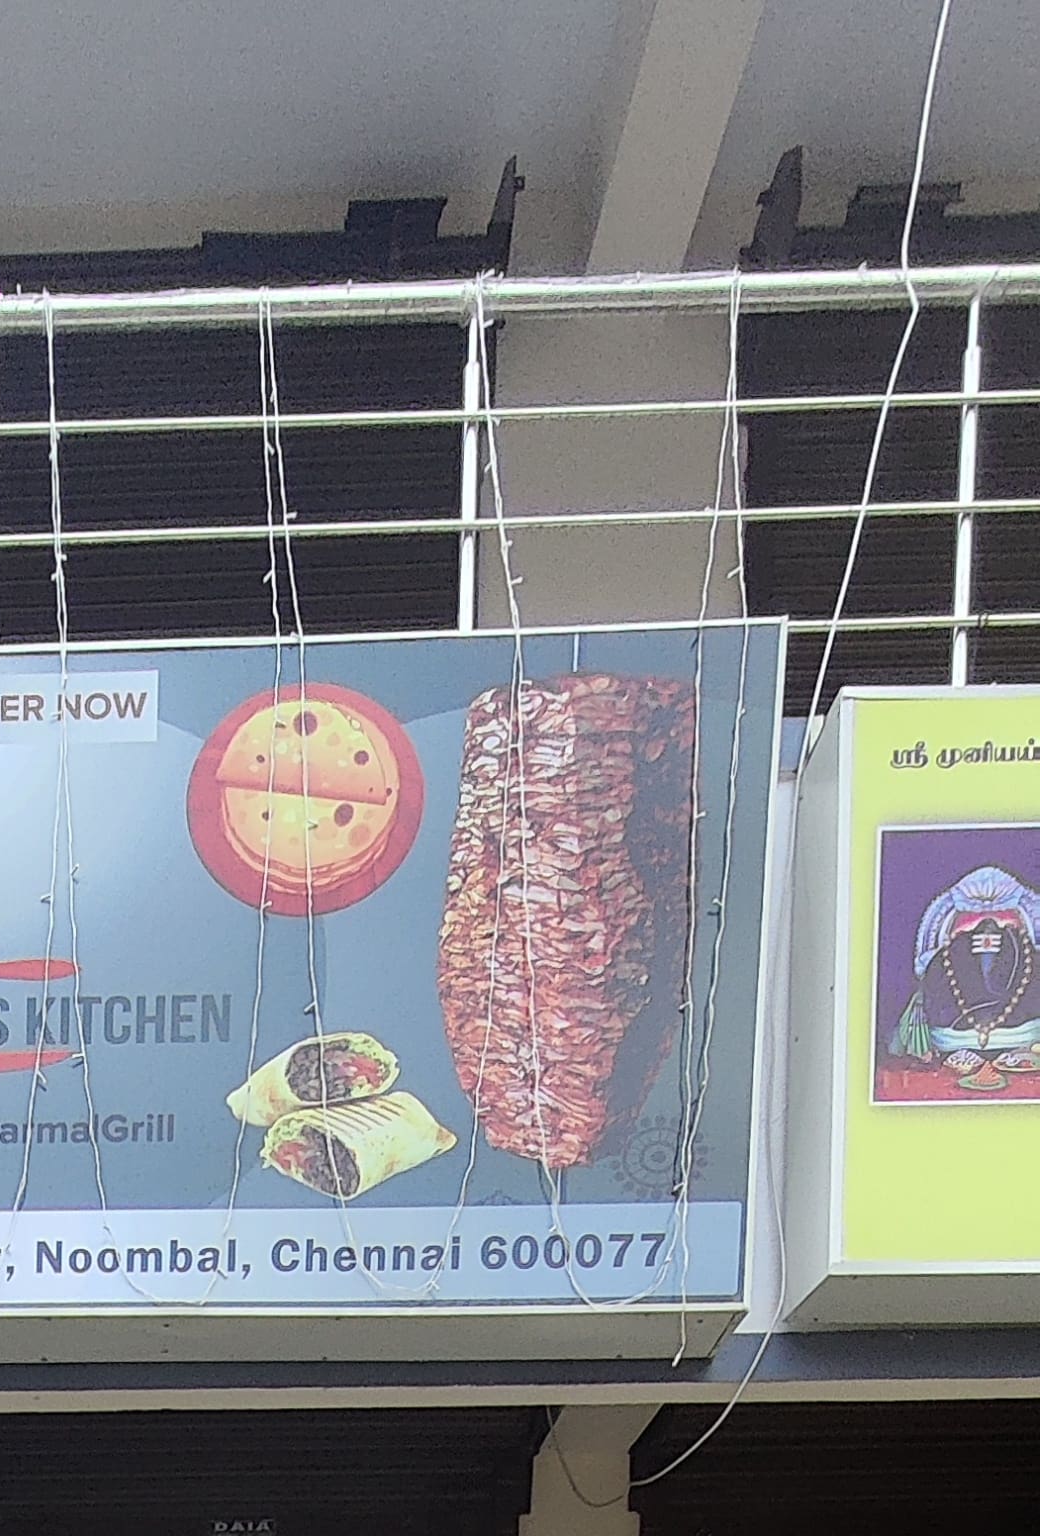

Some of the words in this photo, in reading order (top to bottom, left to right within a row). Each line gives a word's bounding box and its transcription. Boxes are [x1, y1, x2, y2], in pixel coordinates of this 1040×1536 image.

[57, 692, 148, 721] NOW
[25, 994, 232, 1046] KITCHEN
[36, 1239, 252, 1279] Noombal,
[271, 1236, 461, 1272] Chennai
[480, 1232, 666, 1270] 600077
